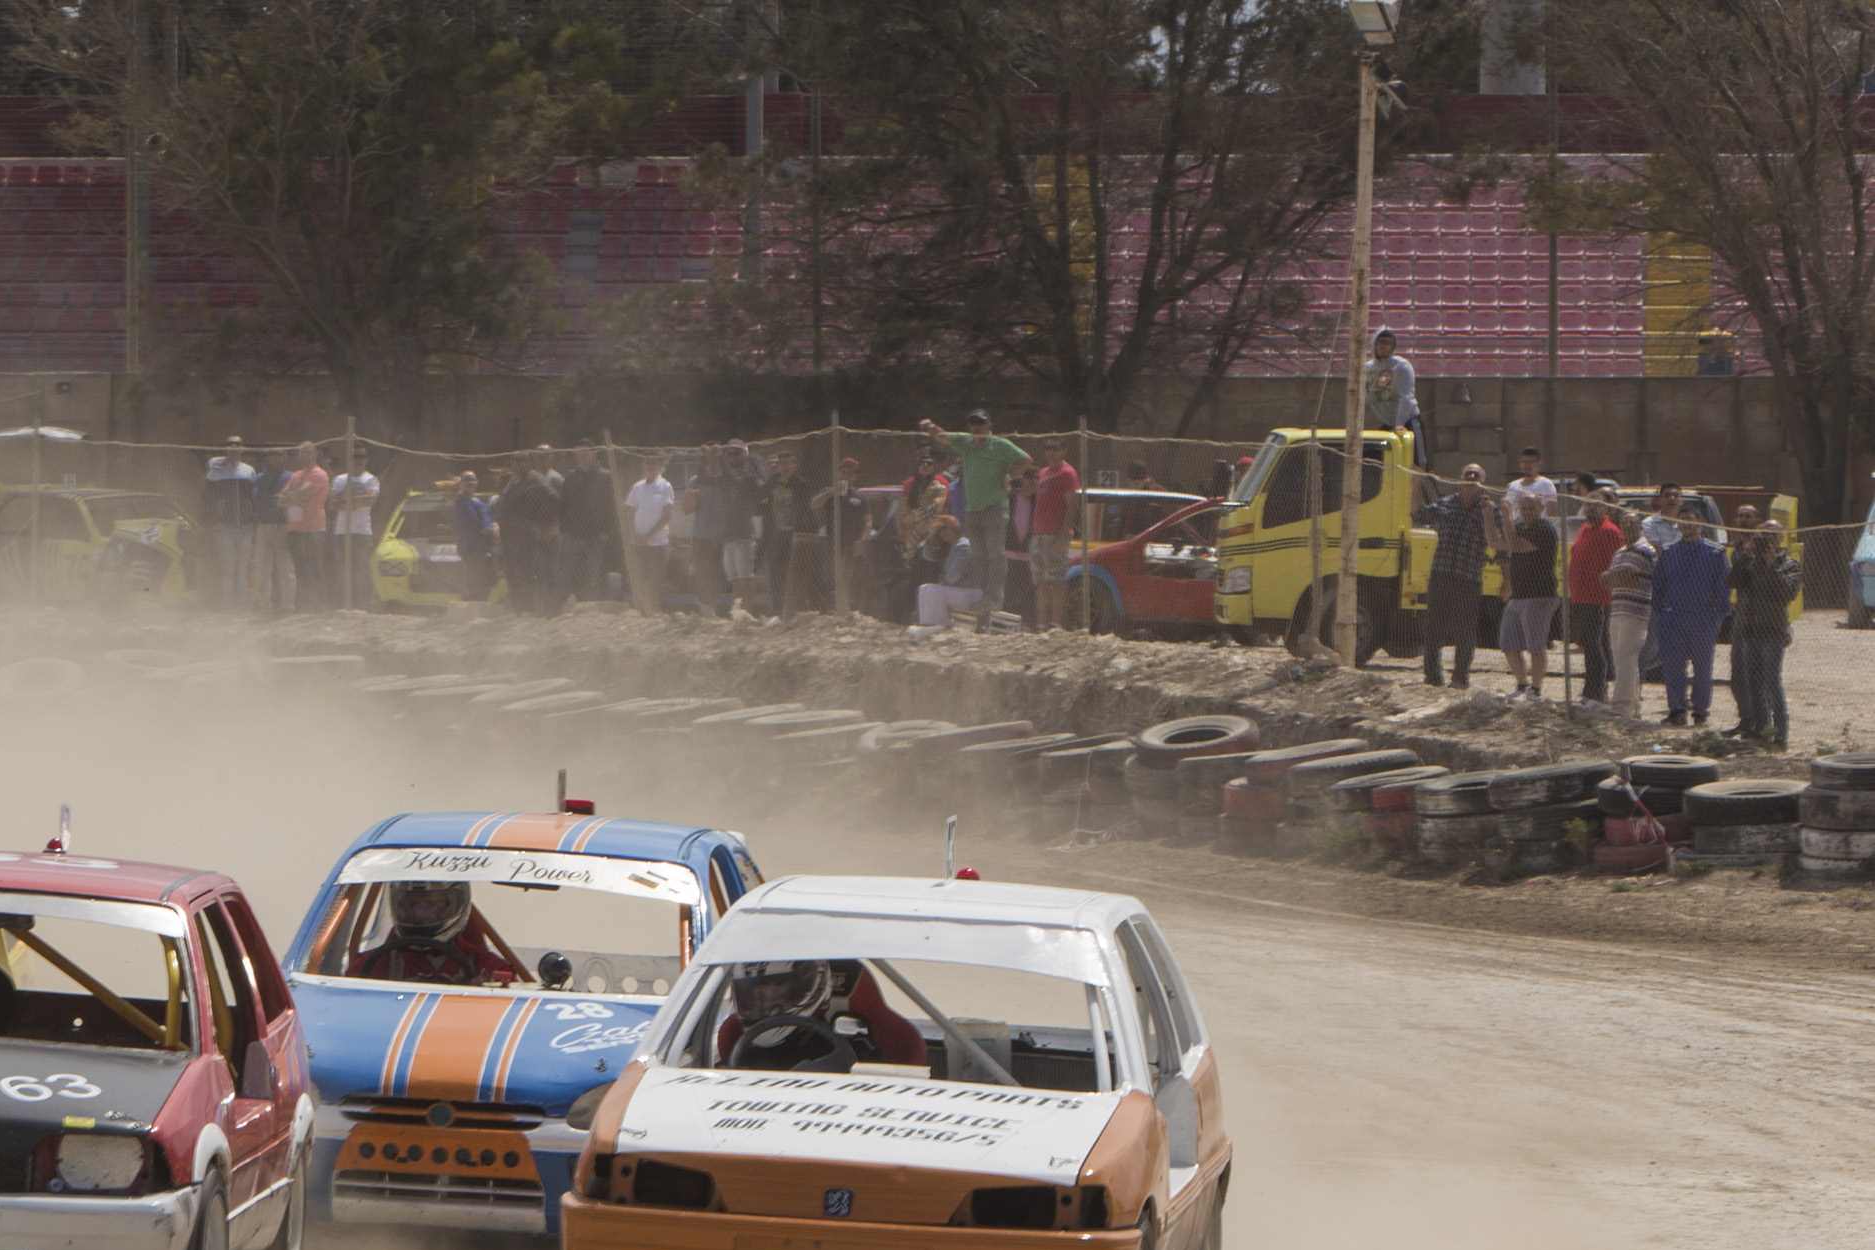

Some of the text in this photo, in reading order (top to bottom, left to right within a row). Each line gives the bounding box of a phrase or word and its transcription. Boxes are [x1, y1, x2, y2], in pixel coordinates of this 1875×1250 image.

[404, 850, 596, 884] Kuzzu Power
[544, 1002, 614, 1020] 28
[835, 1082, 947, 1097] AUTO
[950, 1089, 1086, 1110] PARTS
[706, 1100, 1019, 1130] TOWING SERVICE
